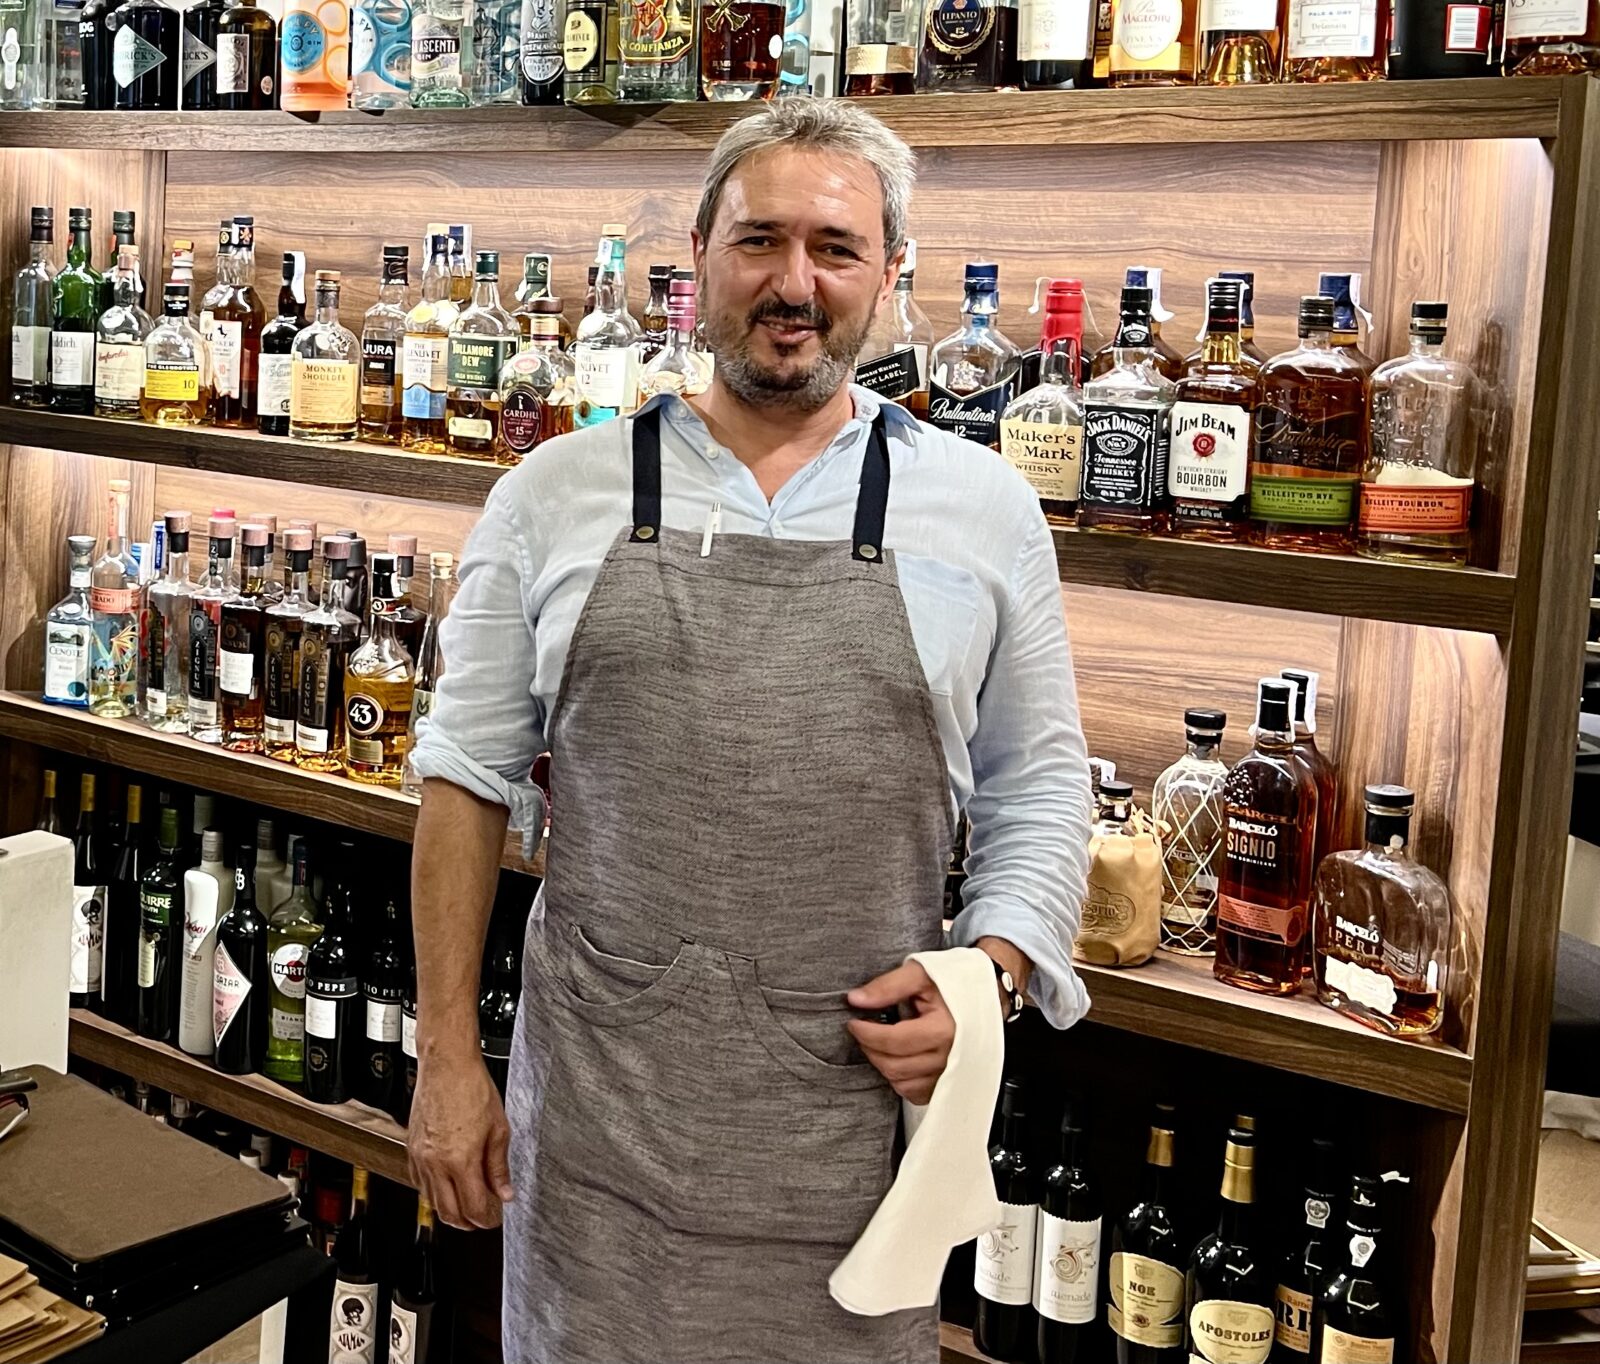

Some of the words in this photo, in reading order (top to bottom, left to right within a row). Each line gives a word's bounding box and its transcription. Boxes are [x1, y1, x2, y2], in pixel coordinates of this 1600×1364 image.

[363, 343, 394, 355] JURA
[452, 340, 494, 358] TULLAMORE
[462, 355, 480, 368] DEW
[306, 365, 343, 373] MONKEY
[878, 369, 908, 382] LABEL
[183, 379, 196, 389] 10
[504, 409, 540, 420] CARDHU
[515, 426, 526, 435] 15
[954, 424, 967, 437] 12
[1086, 420, 1112, 437] JACK
[1112, 414, 1152, 441] DANIEL'S
[1176, 415, 1198, 436] JIM
[1202, 413, 1236, 440] BEAM
[1007, 428, 1076, 445] Maker's
[1024, 445, 1075, 461] Mark
[1015, 463, 1063, 474] WHISKY
[1094, 467, 1136, 477] WHISKEY
[1176, 471, 1227, 488] BOURBON
[1398, 499, 1443, 508] BOURBON
[49, 646, 84, 658] CENOTE
[350, 702, 372, 724] 43
[1228, 816, 1278, 836] BARCELÓ
[1226, 831, 1276, 860] SIGNIO
[1336, 915, 1380, 943] BARCELÓ
[317, 982, 346, 992] PEPE
[1128, 1280, 1156, 1297] NOE
[1198, 1320, 1271, 1343] APOSTOLES
